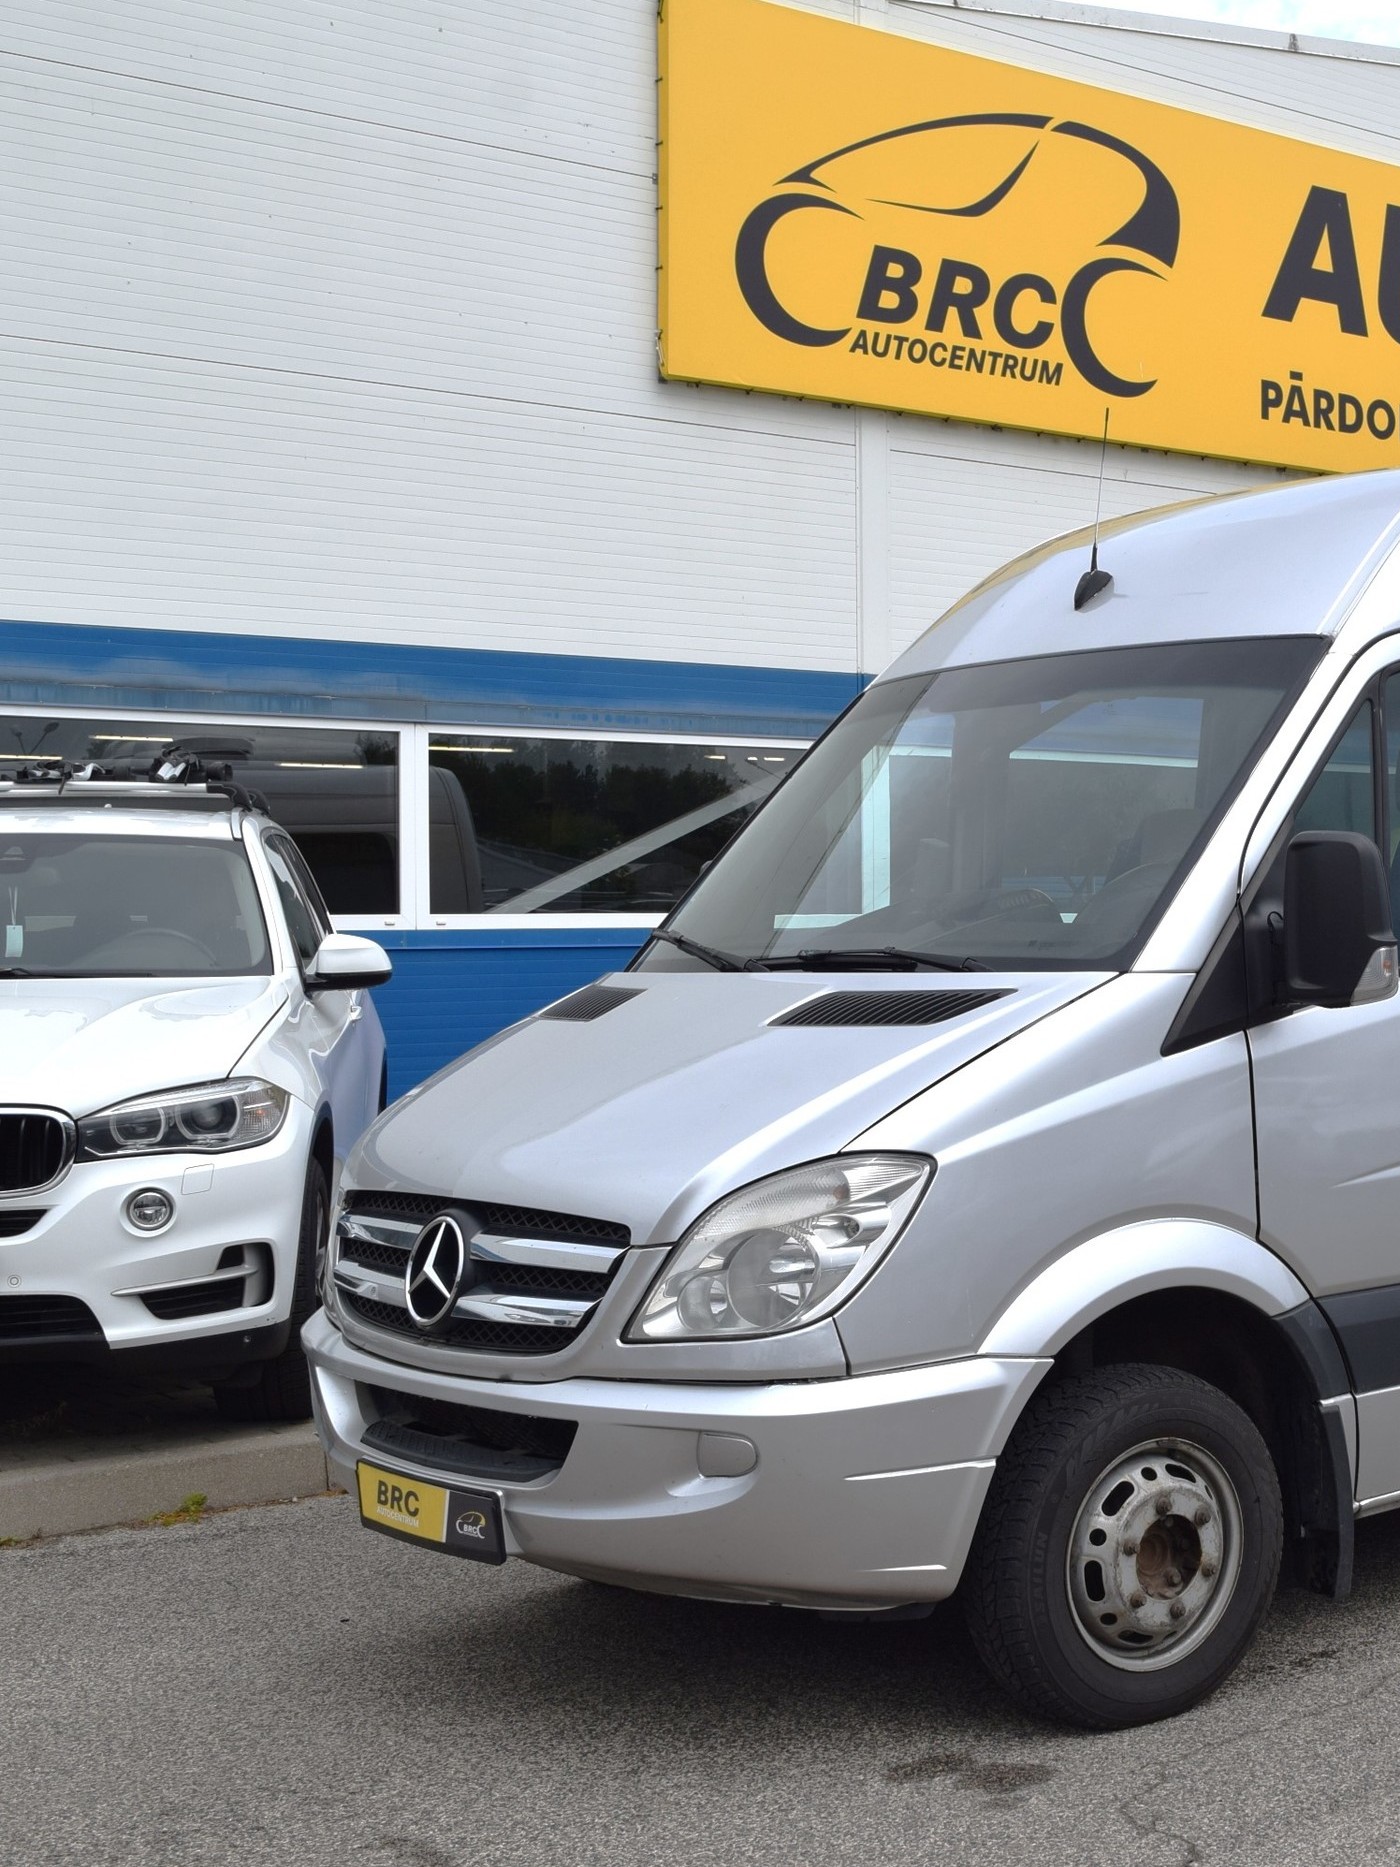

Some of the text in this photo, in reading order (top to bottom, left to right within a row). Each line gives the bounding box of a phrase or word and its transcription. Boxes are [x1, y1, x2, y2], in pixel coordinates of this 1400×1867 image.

[855, 244, 1057, 350] BRC
[849, 328, 1064, 387] AUTOCENTRUM
[376, 1506, 420, 1528] AUTOCENTRUM
[377, 1480, 420, 1517] BRC
